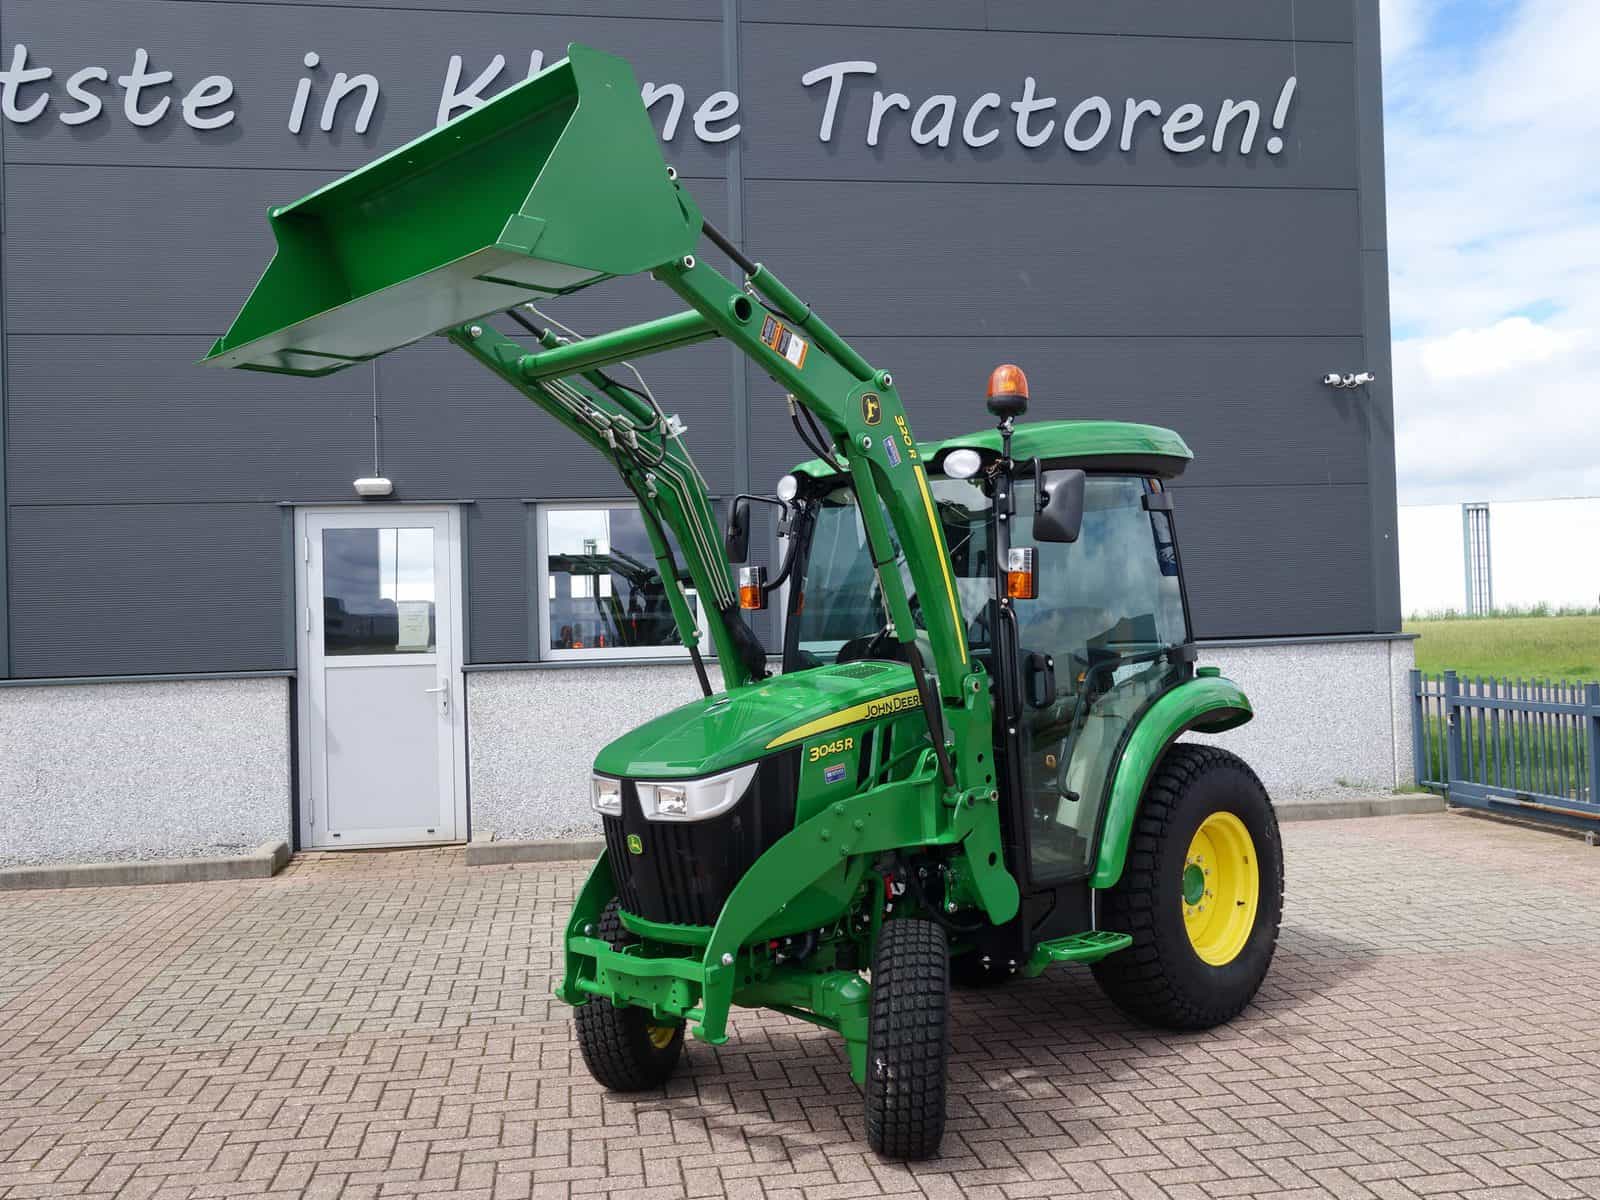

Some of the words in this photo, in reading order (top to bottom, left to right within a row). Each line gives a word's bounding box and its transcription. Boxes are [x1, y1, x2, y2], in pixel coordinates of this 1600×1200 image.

[0, 43, 235, 130] tste
[288, 51, 380, 134] in
[436, 49, 741, 142] Kne
[802, 61, 1297, 154] Tractoren!
[894, 415, 912, 446] 320
[865, 701, 893, 719] JOHN
[893, 695, 920, 710] DEER
[809, 737, 853, 762] 3045R
